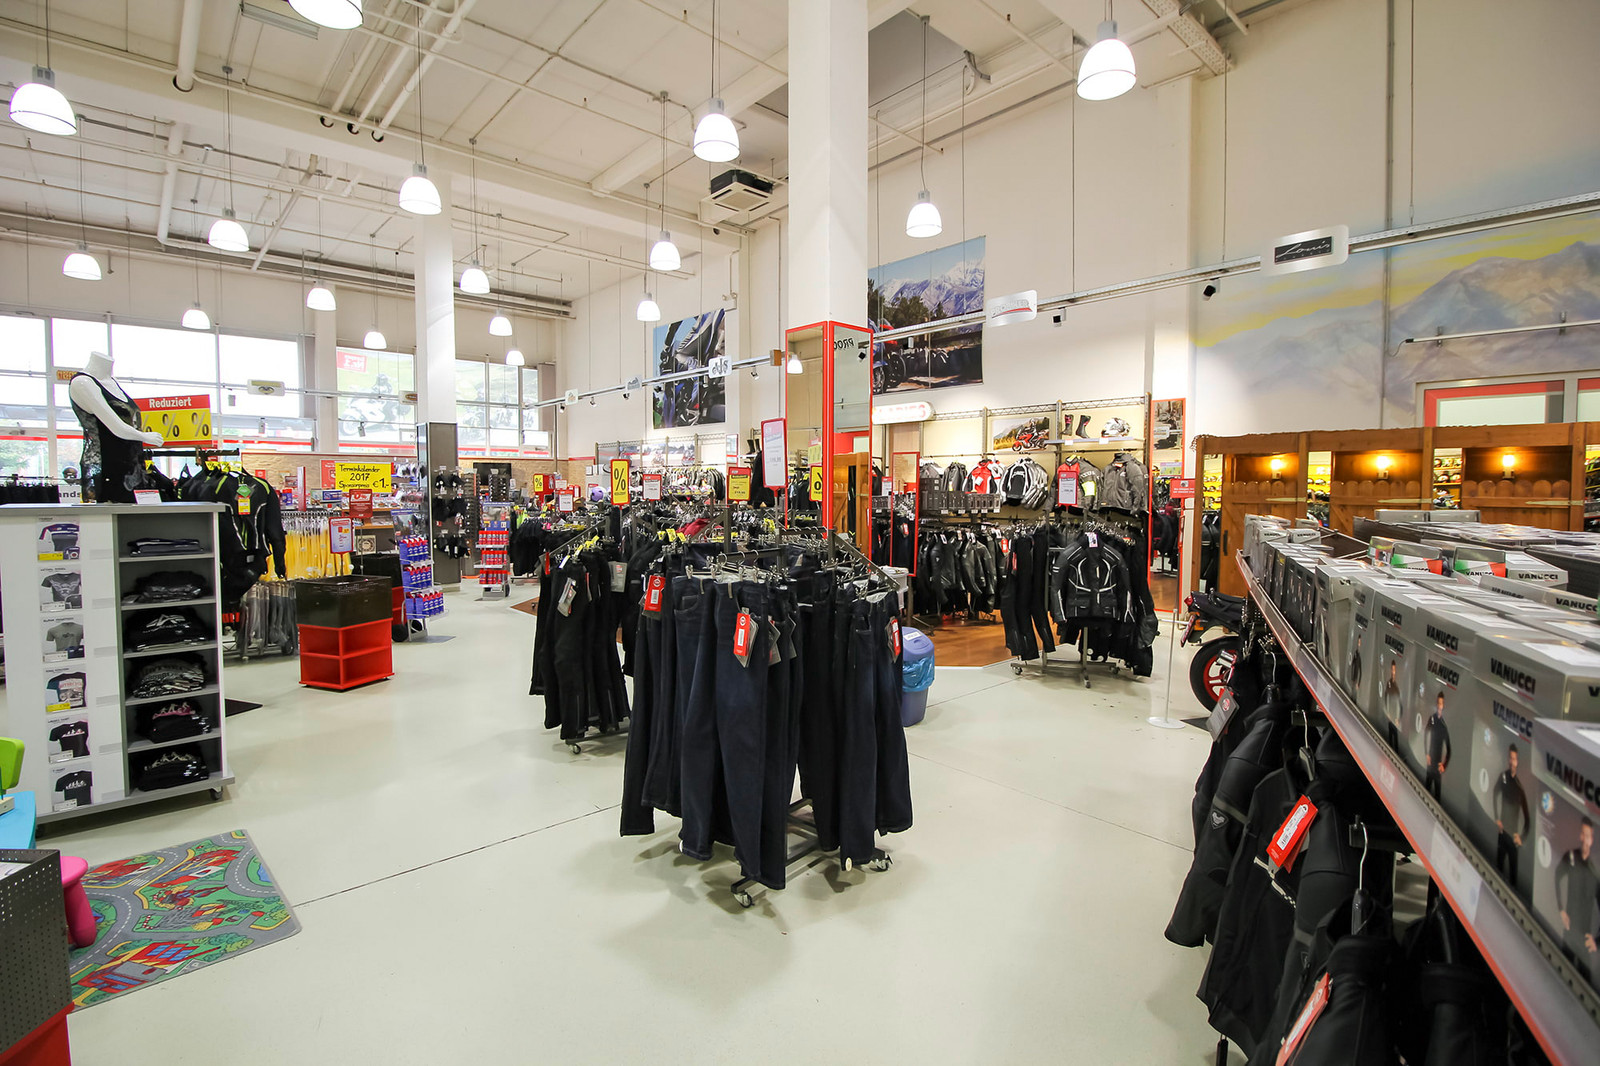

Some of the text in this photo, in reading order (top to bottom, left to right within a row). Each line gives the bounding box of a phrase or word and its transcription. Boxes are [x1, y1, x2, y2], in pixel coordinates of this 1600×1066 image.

[1275, 240, 1330, 259] Louis
[148, 396, 192, 408] Reduziert
[350, 472, 370, 481] 2017
[1384, 633, 1405, 655] VANUCCI
[1426, 624, 1459, 652] VANUCCI
[1427, 659, 1460, 687] VANUCCI
[1490, 657, 1537, 695] VANUCCI
